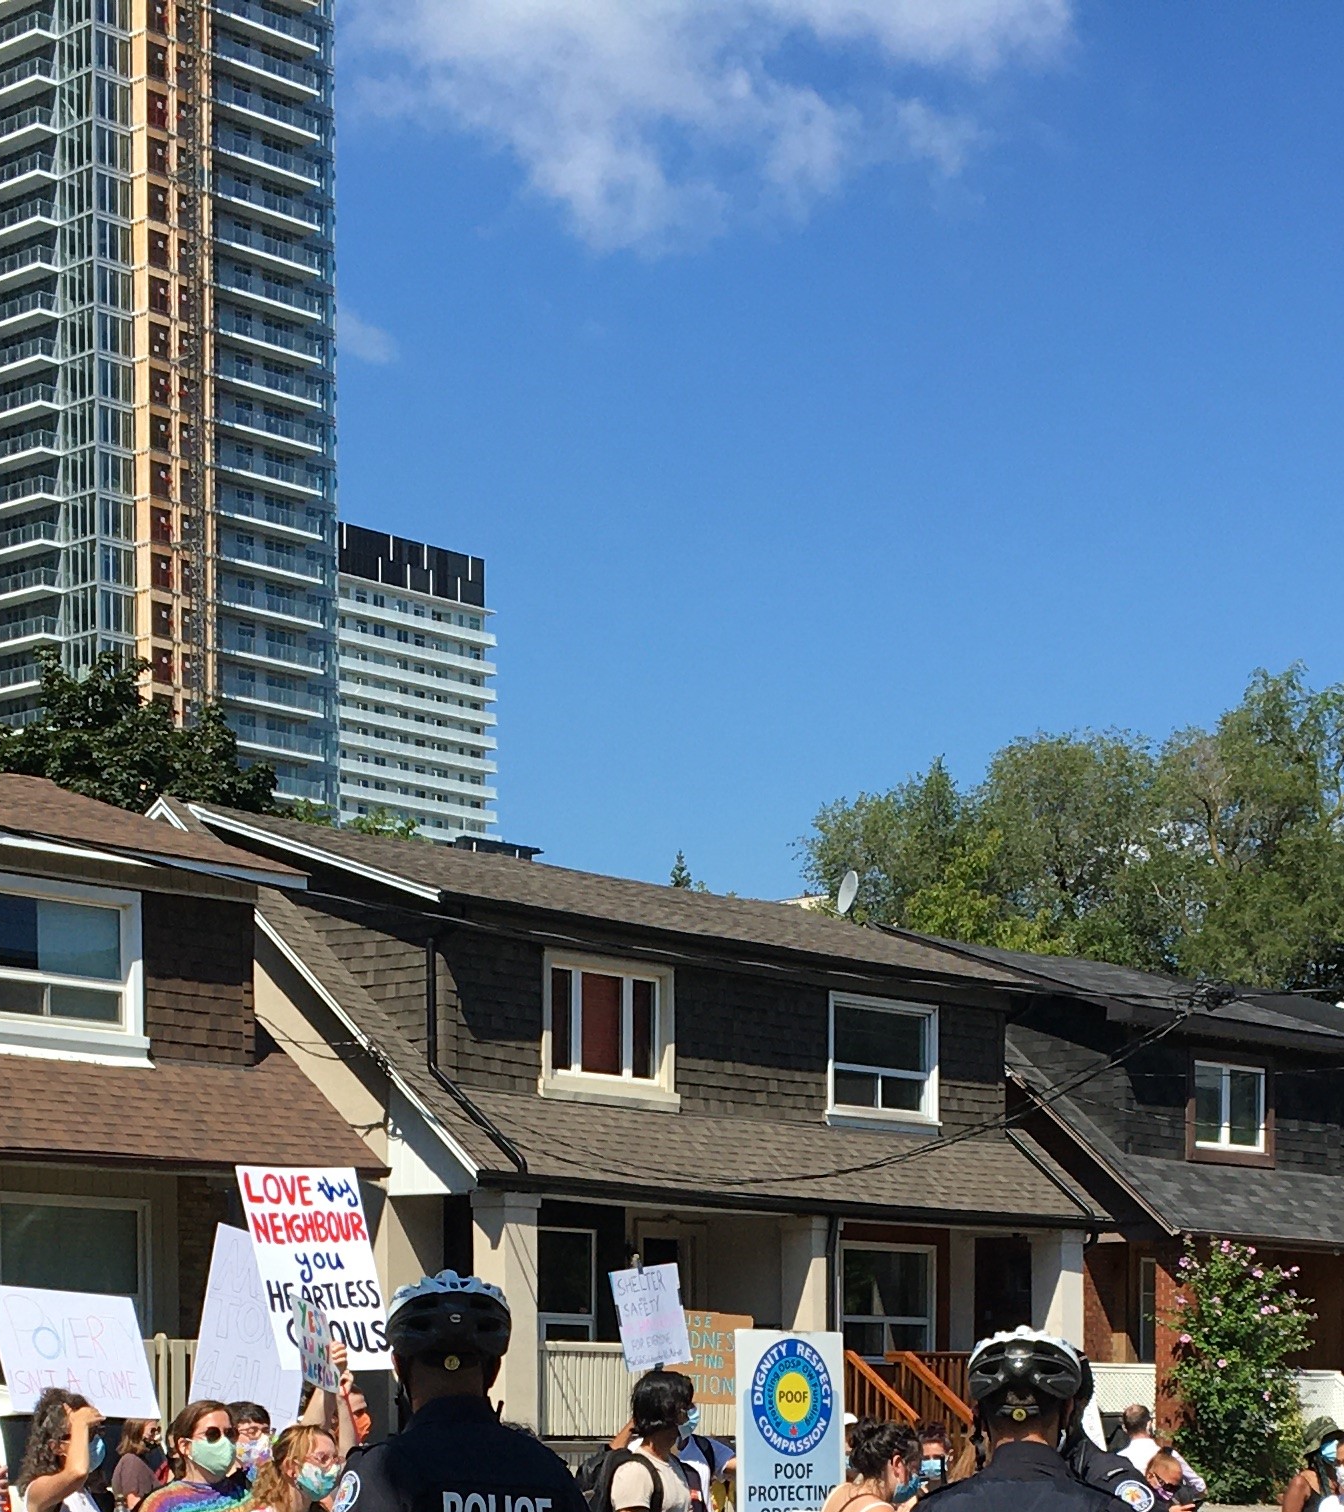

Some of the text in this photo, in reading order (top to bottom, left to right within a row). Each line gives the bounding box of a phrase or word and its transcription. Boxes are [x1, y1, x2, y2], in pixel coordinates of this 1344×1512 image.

[244, 1171, 358, 1207] LOVE thy
[250, 1210, 367, 1245] NEIGHBOUR
[294, 1252, 345, 1283] you
[617, 1270, 667, 1297] SHELTER
[266, 1279, 380, 1313] HEARTLESS
[623, 1295, 661, 1318] SAFETY
[2, 1294, 140, 1364] POVERTY
[753, 1343, 831, 1408] DIGNITY RESPECT
[778, 1360, 802, 1373] ODSP
[8, 1367, 142, 1402] ISN'T A CRIME
[778, 1390, 809, 1403] POOF
[758, 1415, 827, 1453] COMPASSION
[774, 1463, 814, 1479] POOF
